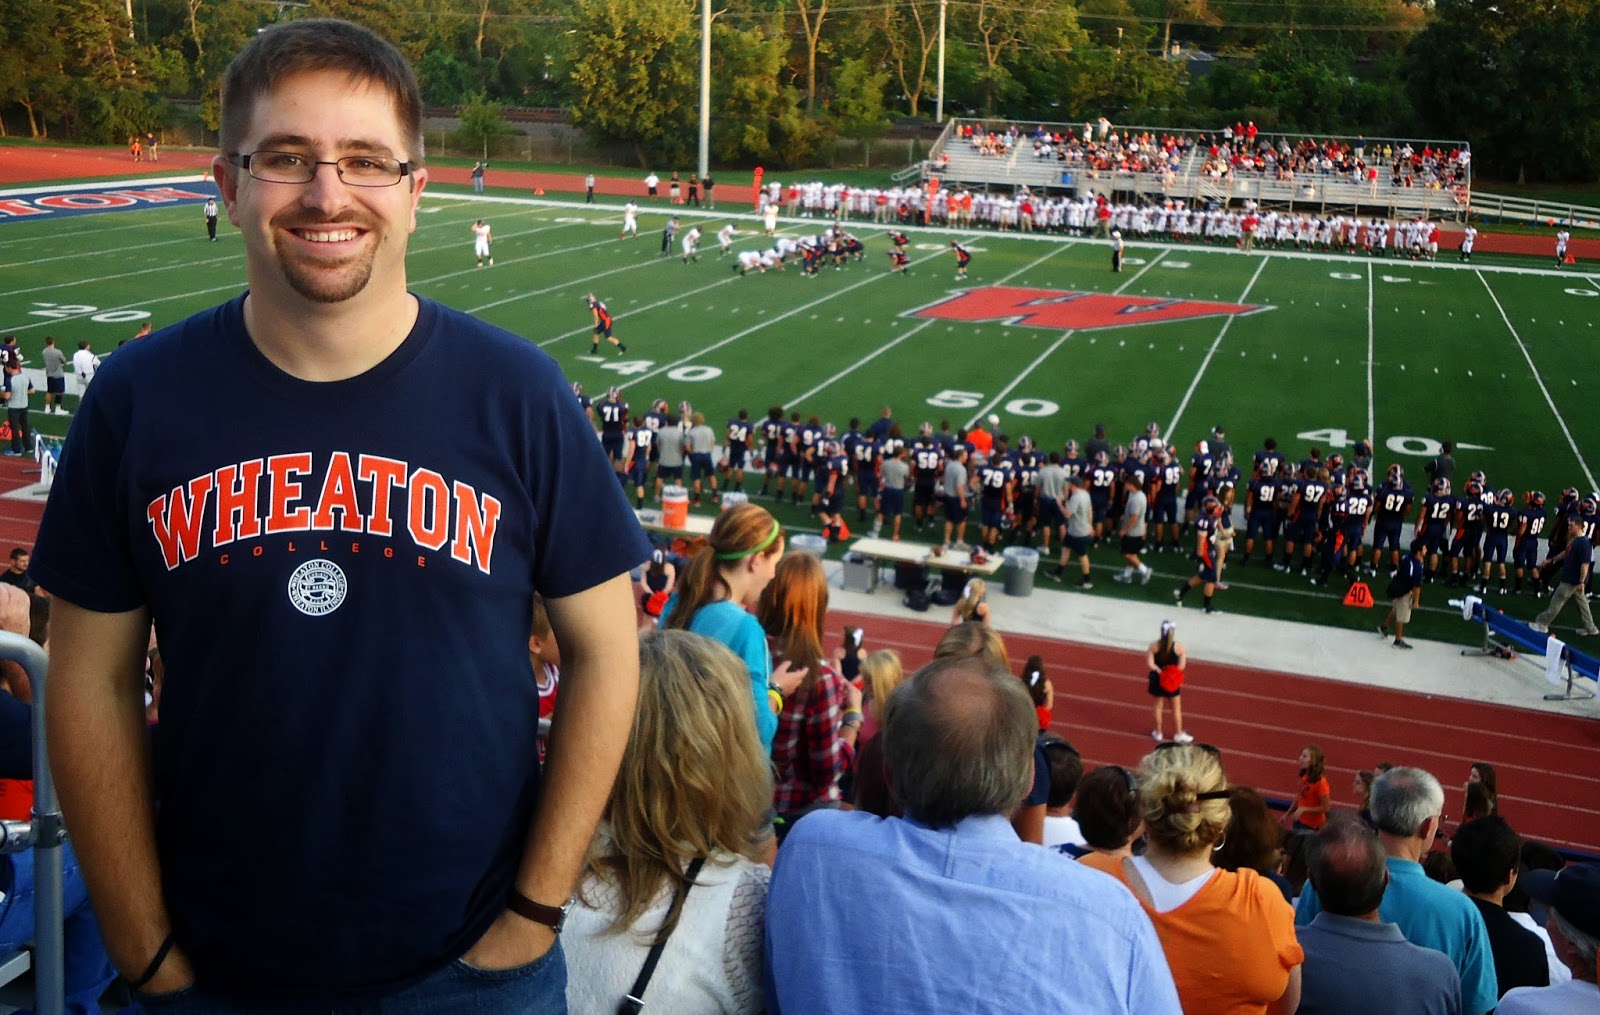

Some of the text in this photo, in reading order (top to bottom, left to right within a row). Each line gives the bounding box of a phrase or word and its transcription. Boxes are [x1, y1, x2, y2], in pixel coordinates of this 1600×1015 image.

[0, 188, 216, 217] TON
[926, 389, 1060, 417] 50
[602, 405, 620, 422] 71
[729, 424, 748, 442] 24
[1296, 428, 1444, 457] 40
[982, 468, 1005, 488] 79
[1259, 484, 1275, 502] 91
[1304, 484, 1325, 503] 97
[147, 451, 502, 575] WHEATON
[1431, 502, 1451, 519] 12
[1492, 511, 1510, 529] 13
[219, 540, 426, 569] COLLEGE
[1350, 585, 1366, 604] 40
